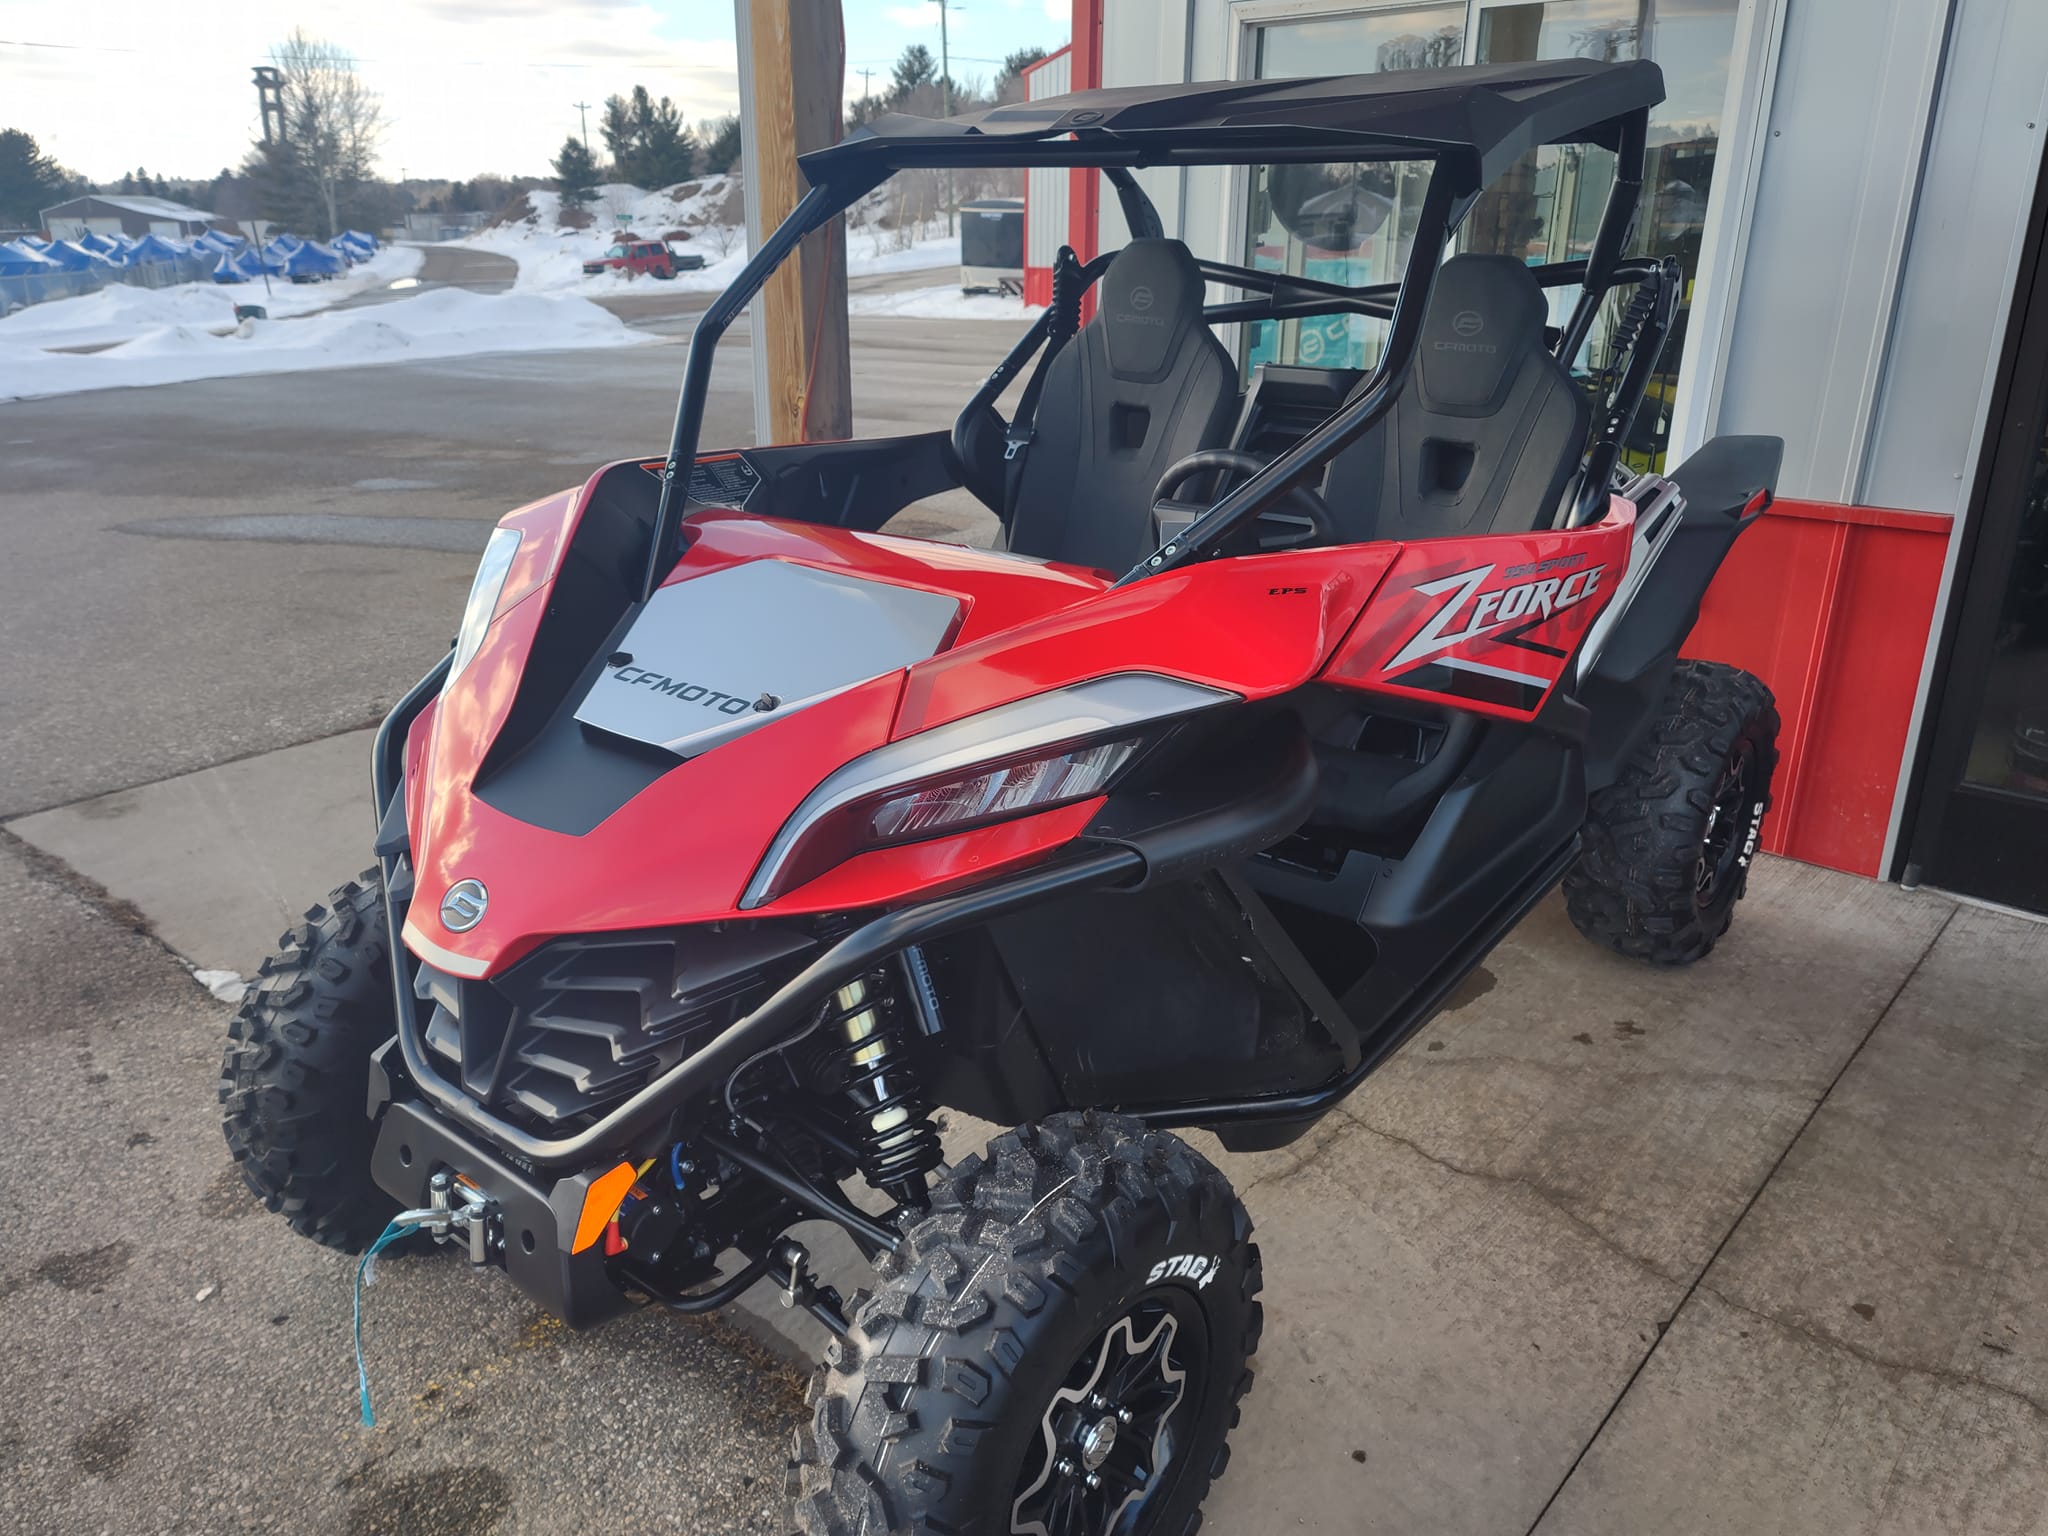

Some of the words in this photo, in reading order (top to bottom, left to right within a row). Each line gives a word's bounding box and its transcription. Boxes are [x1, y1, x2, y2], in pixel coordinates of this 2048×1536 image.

[1433, 341, 1497, 354] CFMOTO
[1537, 552, 1588, 573] SPORT
[1268, 587, 1307, 596] EPS
[613, 666, 751, 715] CFMOTO
[1743, 802, 1764, 855] STAG
[911, 945, 939, 1010] FMOTO
[1145, 1254, 1208, 1286] STAG
